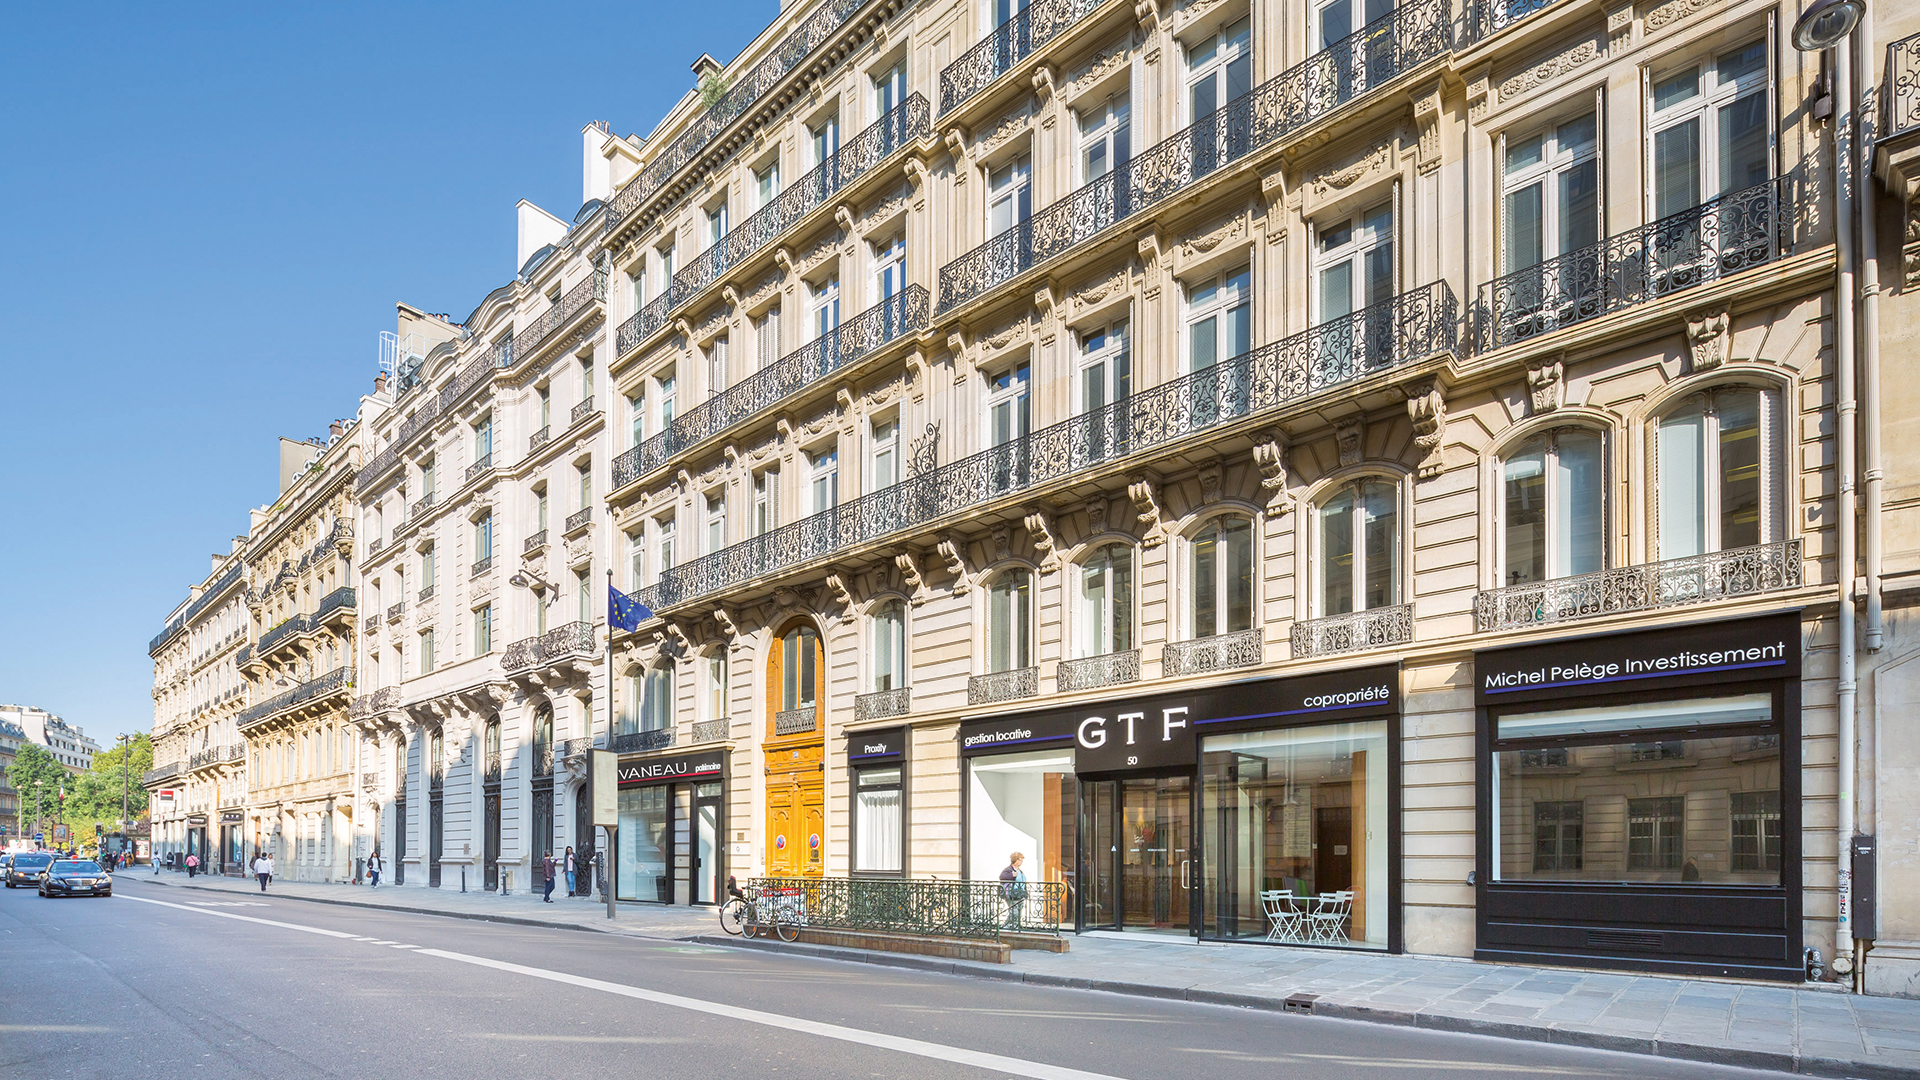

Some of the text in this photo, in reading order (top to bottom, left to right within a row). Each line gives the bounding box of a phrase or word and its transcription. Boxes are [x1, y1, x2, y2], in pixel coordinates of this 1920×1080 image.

[1485, 641, 1785, 688] Michel Pelège Investissement
[1303, 685, 1390, 708] copropriété
[964, 728, 1032, 747] gestion locative
[1127, 756, 1138, 765] 50
[618, 762, 687, 780] VANEAU
